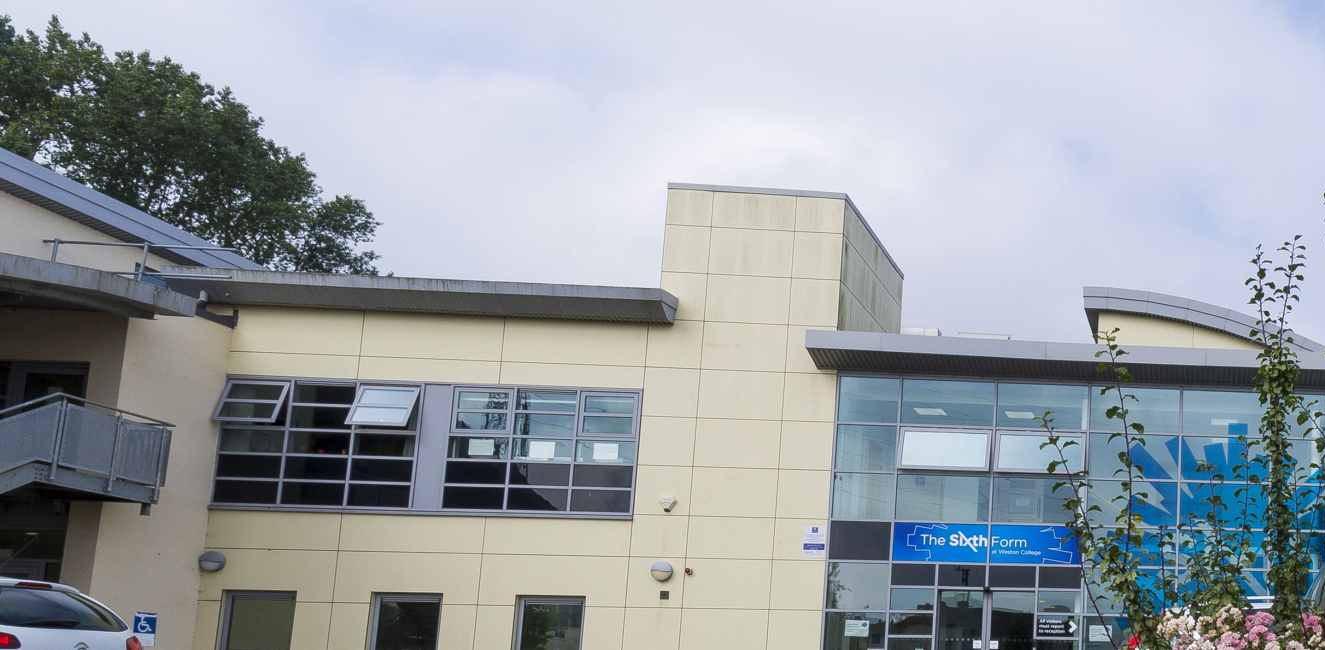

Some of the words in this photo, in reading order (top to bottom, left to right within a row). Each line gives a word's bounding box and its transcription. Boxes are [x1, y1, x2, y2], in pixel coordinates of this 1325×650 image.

[920, 534, 946, 546] The
[949, 530, 988, 553] Sixth
[991, 536, 1027, 548] Form
